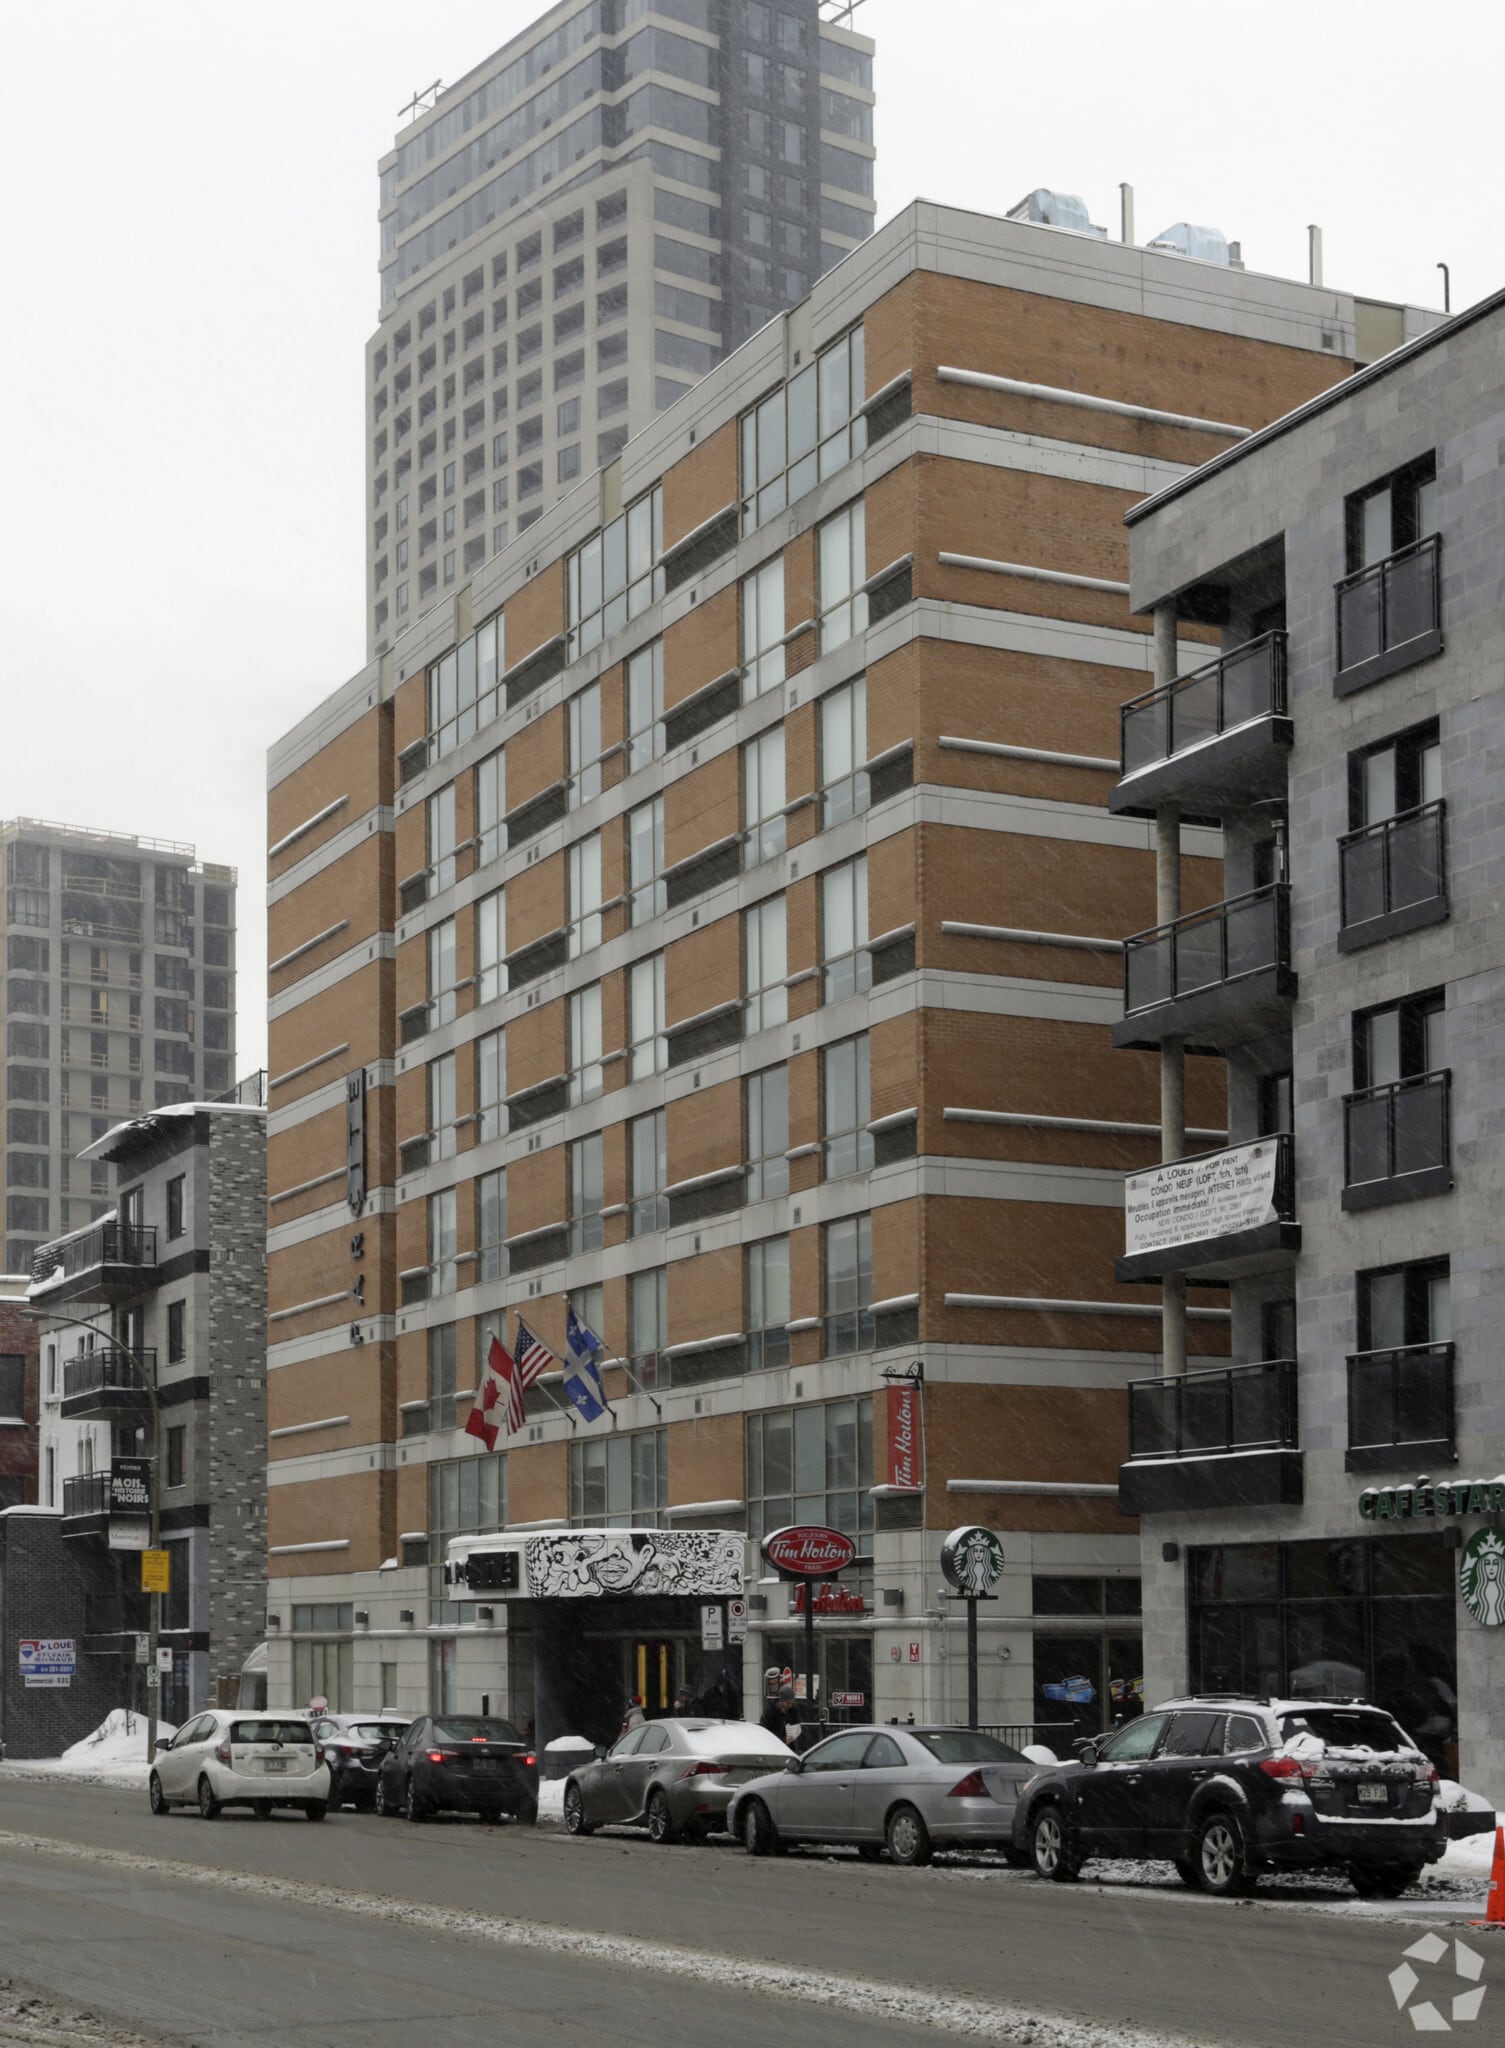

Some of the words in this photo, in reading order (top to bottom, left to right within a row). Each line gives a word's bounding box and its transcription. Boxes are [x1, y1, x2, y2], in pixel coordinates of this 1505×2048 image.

[1205, 1160, 1220, 1171] FOR
[1222, 1155, 1238, 1167] RENT
[1151, 1183, 1173, 1197] CONDO
[1176, 1177, 1193, 1189] NEUF
[1207, 1179, 1235, 1195] INTERNET
[1135, 1207, 1171, 1223] Occupation
[1172, 1211, 1194, 1224] CONDO
[894, 1390, 912, 1455] Hortons
[895, 1455, 912, 1487] Tim
[112, 1477, 142, 1489] MOIS
[117, 1493, 150, 1504] NOIRS
[1358, 1475, 1433, 1521] CAFÉ
[772, 1539, 799, 1559] Tim
[799, 1539, 853, 1559] Hortons
[708, 1607, 716, 1619] P
